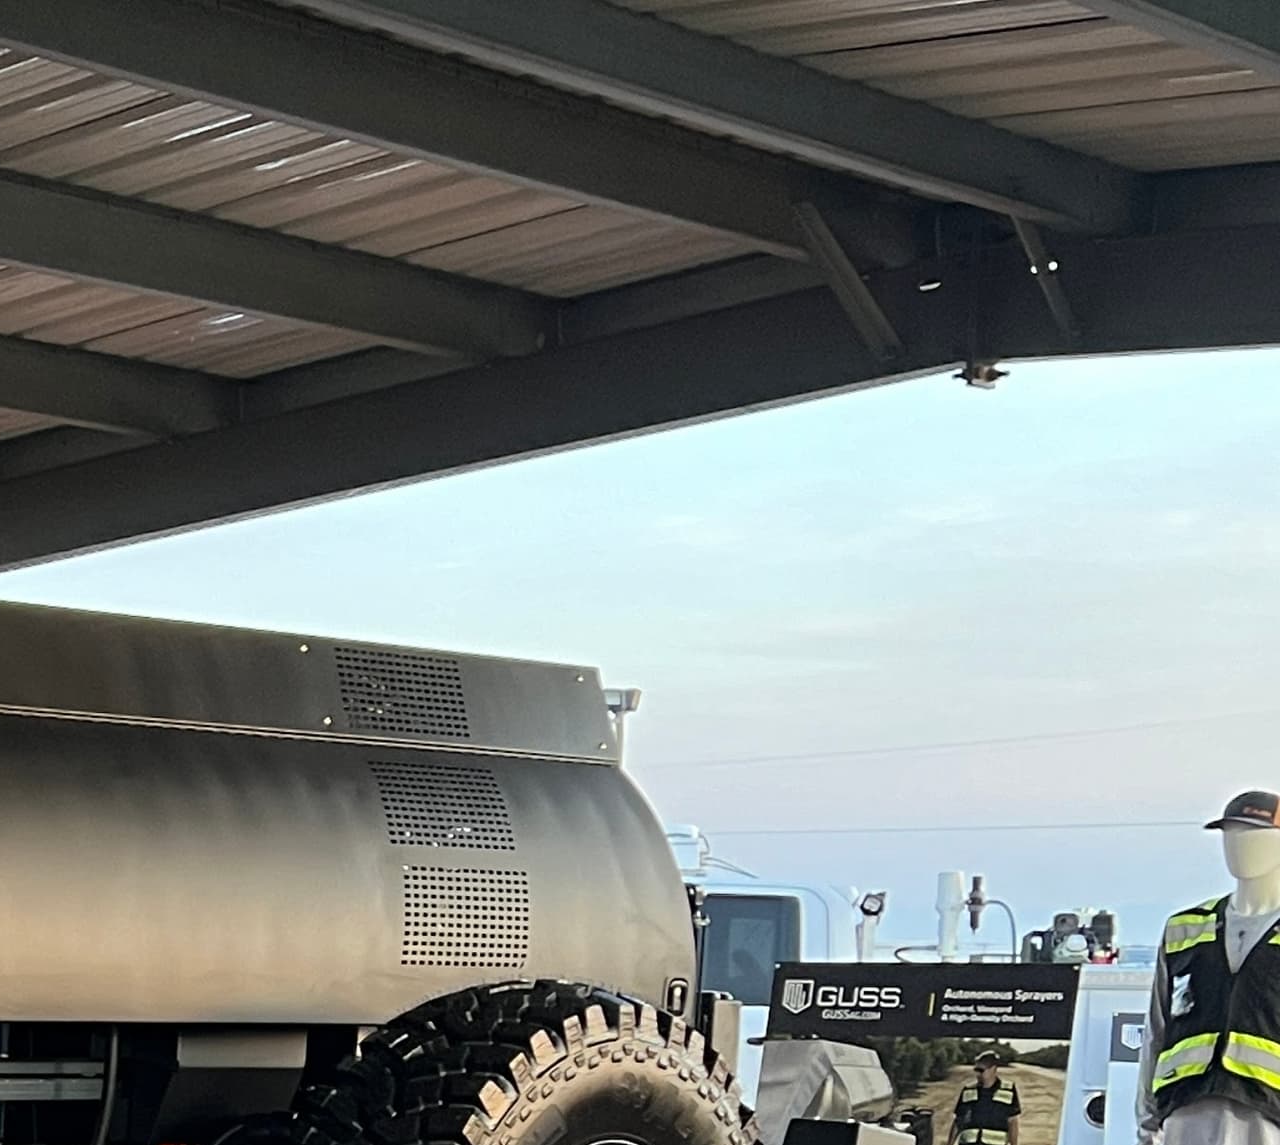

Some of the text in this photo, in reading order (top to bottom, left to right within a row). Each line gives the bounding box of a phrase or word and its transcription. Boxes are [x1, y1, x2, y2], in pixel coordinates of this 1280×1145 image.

[816, 986, 902, 1008] GUSS
[944, 988, 1064, 1003] Autonomous Sprayers
